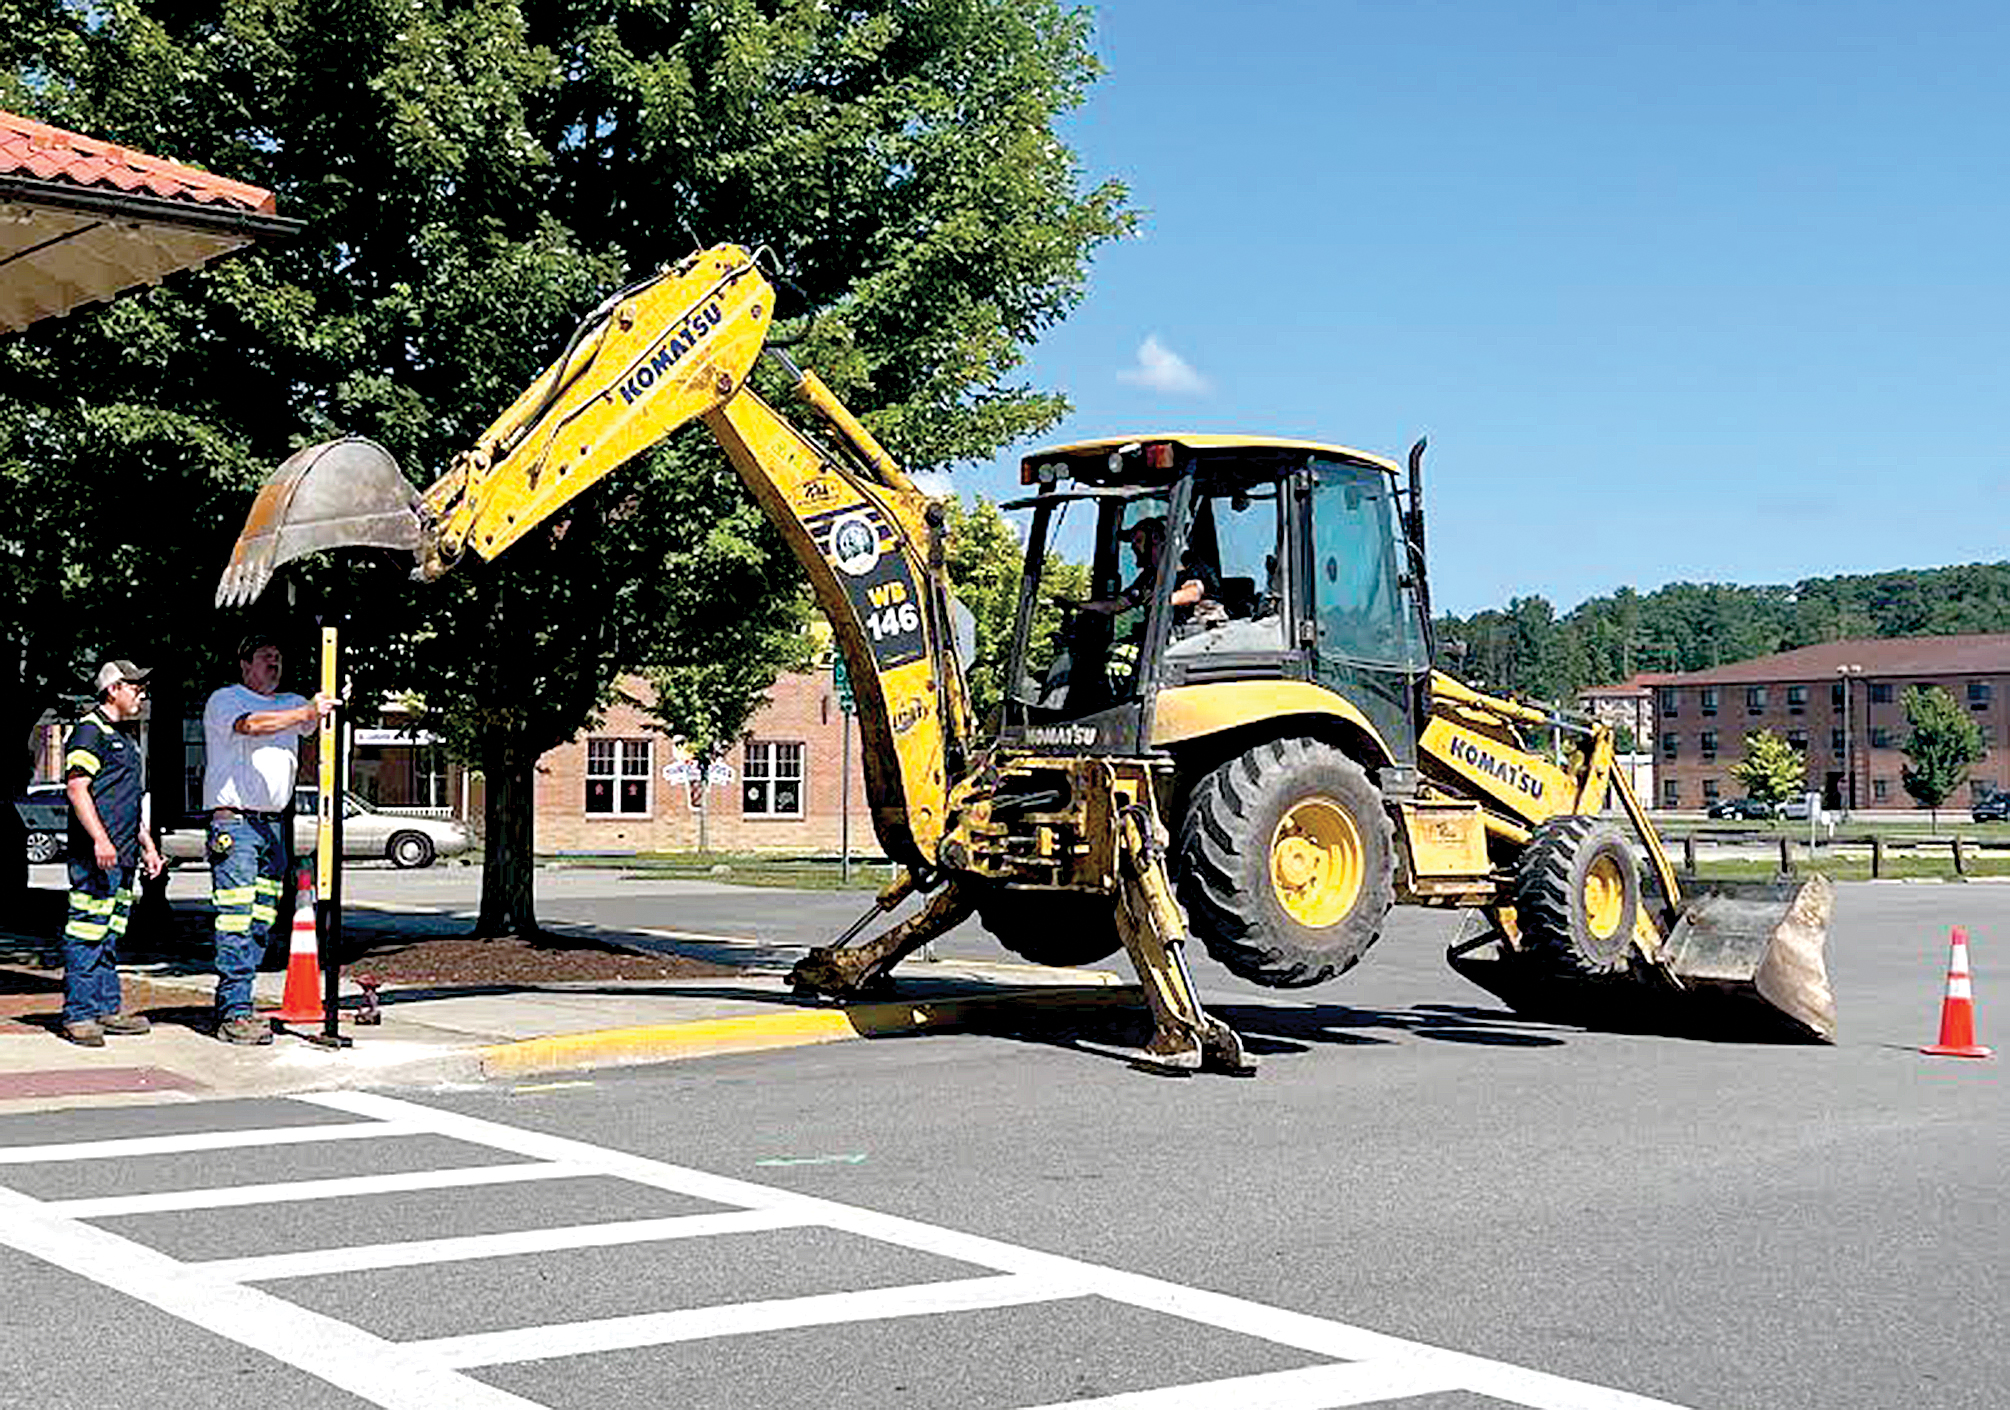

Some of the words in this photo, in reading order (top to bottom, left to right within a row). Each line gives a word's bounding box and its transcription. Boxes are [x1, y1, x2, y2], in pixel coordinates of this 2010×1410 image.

[618, 302, 722, 405] KOMATSU
[867, 581, 908, 608] WB
[866, 603, 919, 641] 146
[1450, 735, 1544, 800] KOMATSU
